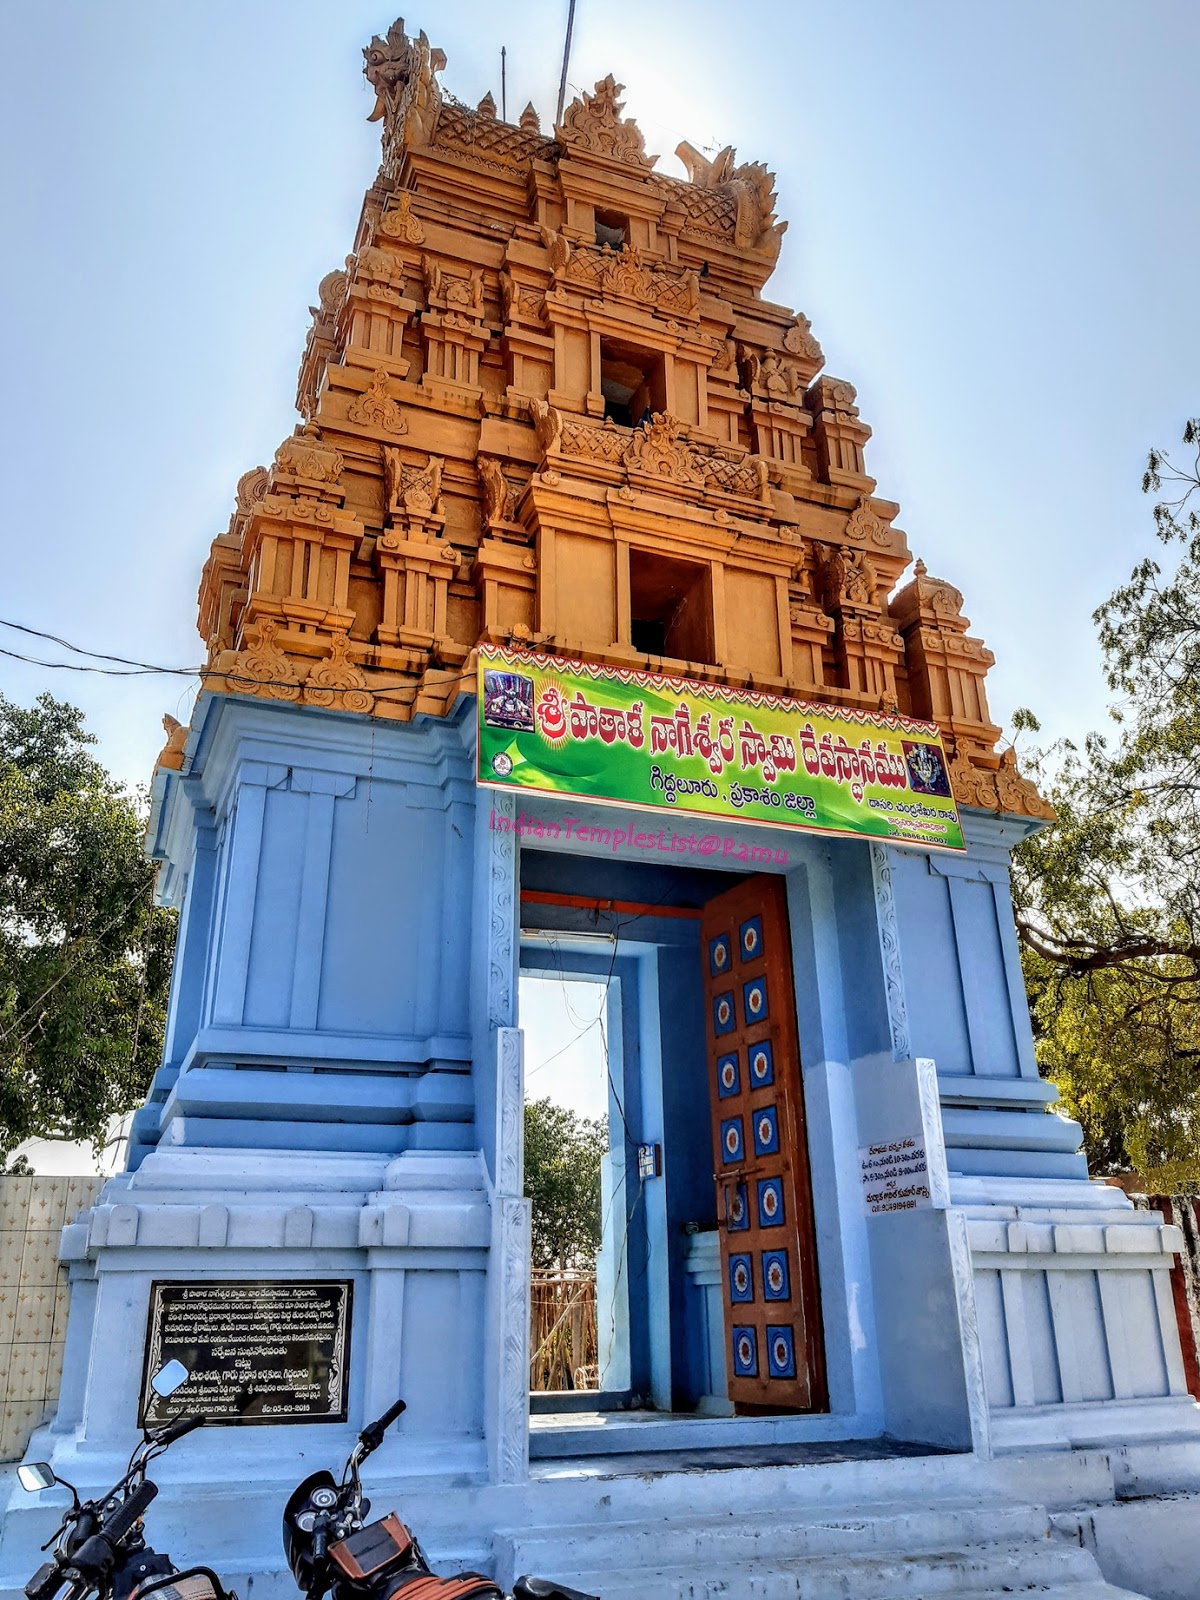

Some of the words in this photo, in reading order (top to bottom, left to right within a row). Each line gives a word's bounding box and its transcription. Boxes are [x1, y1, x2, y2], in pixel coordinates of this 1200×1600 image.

[537, 687, 567, 739] శ్రీ
[570, 692, 645, 748] పాతాళ
[651, 702, 735, 775] నాగేశ్వర
[739, 720, 797, 783] స్వామి
[800, 723, 907, 802] దేవస్థానము
[651, 766, 718, 803] గిద్దలూరు
[730, 782, 781, 808] ప్రకాశం
[784, 793, 816, 817] జిల్లా
[868, 799, 893, 810] దాసరి
[938, 810, 958, 823] రావు
